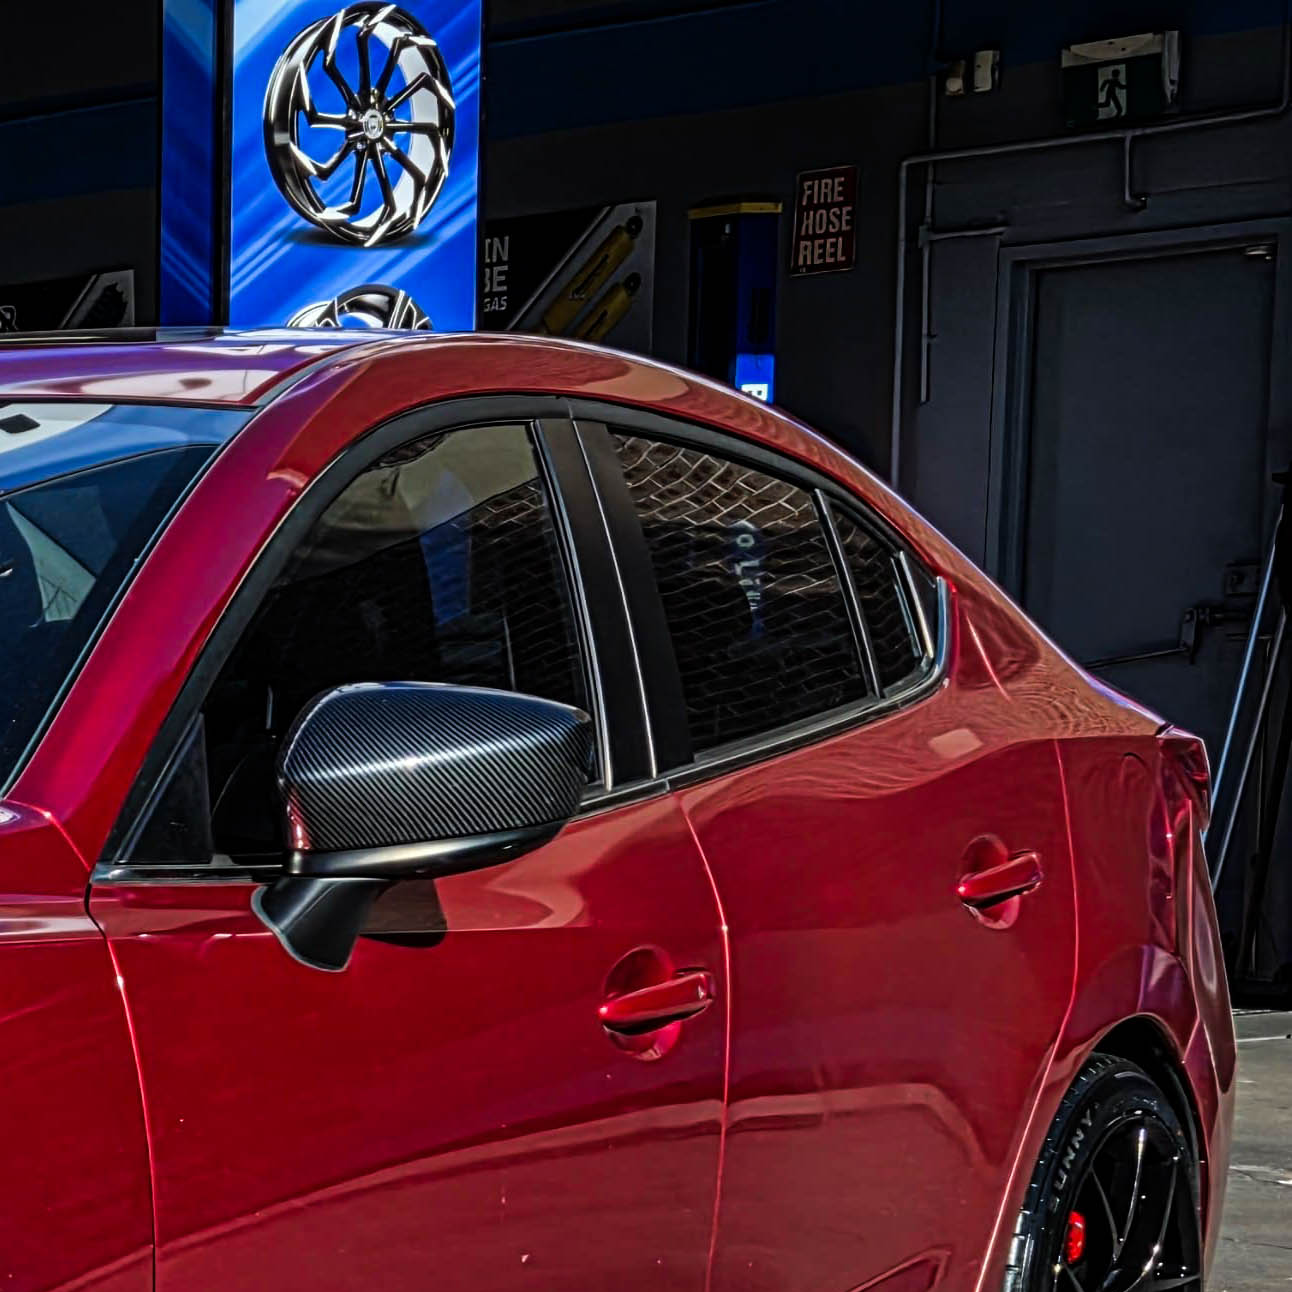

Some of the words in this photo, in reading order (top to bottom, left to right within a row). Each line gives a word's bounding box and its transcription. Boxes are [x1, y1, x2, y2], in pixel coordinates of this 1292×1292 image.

[801, 176, 846, 206] FIRE
[800, 206, 854, 236] HOSE
[797, 237, 847, 267] REEL
